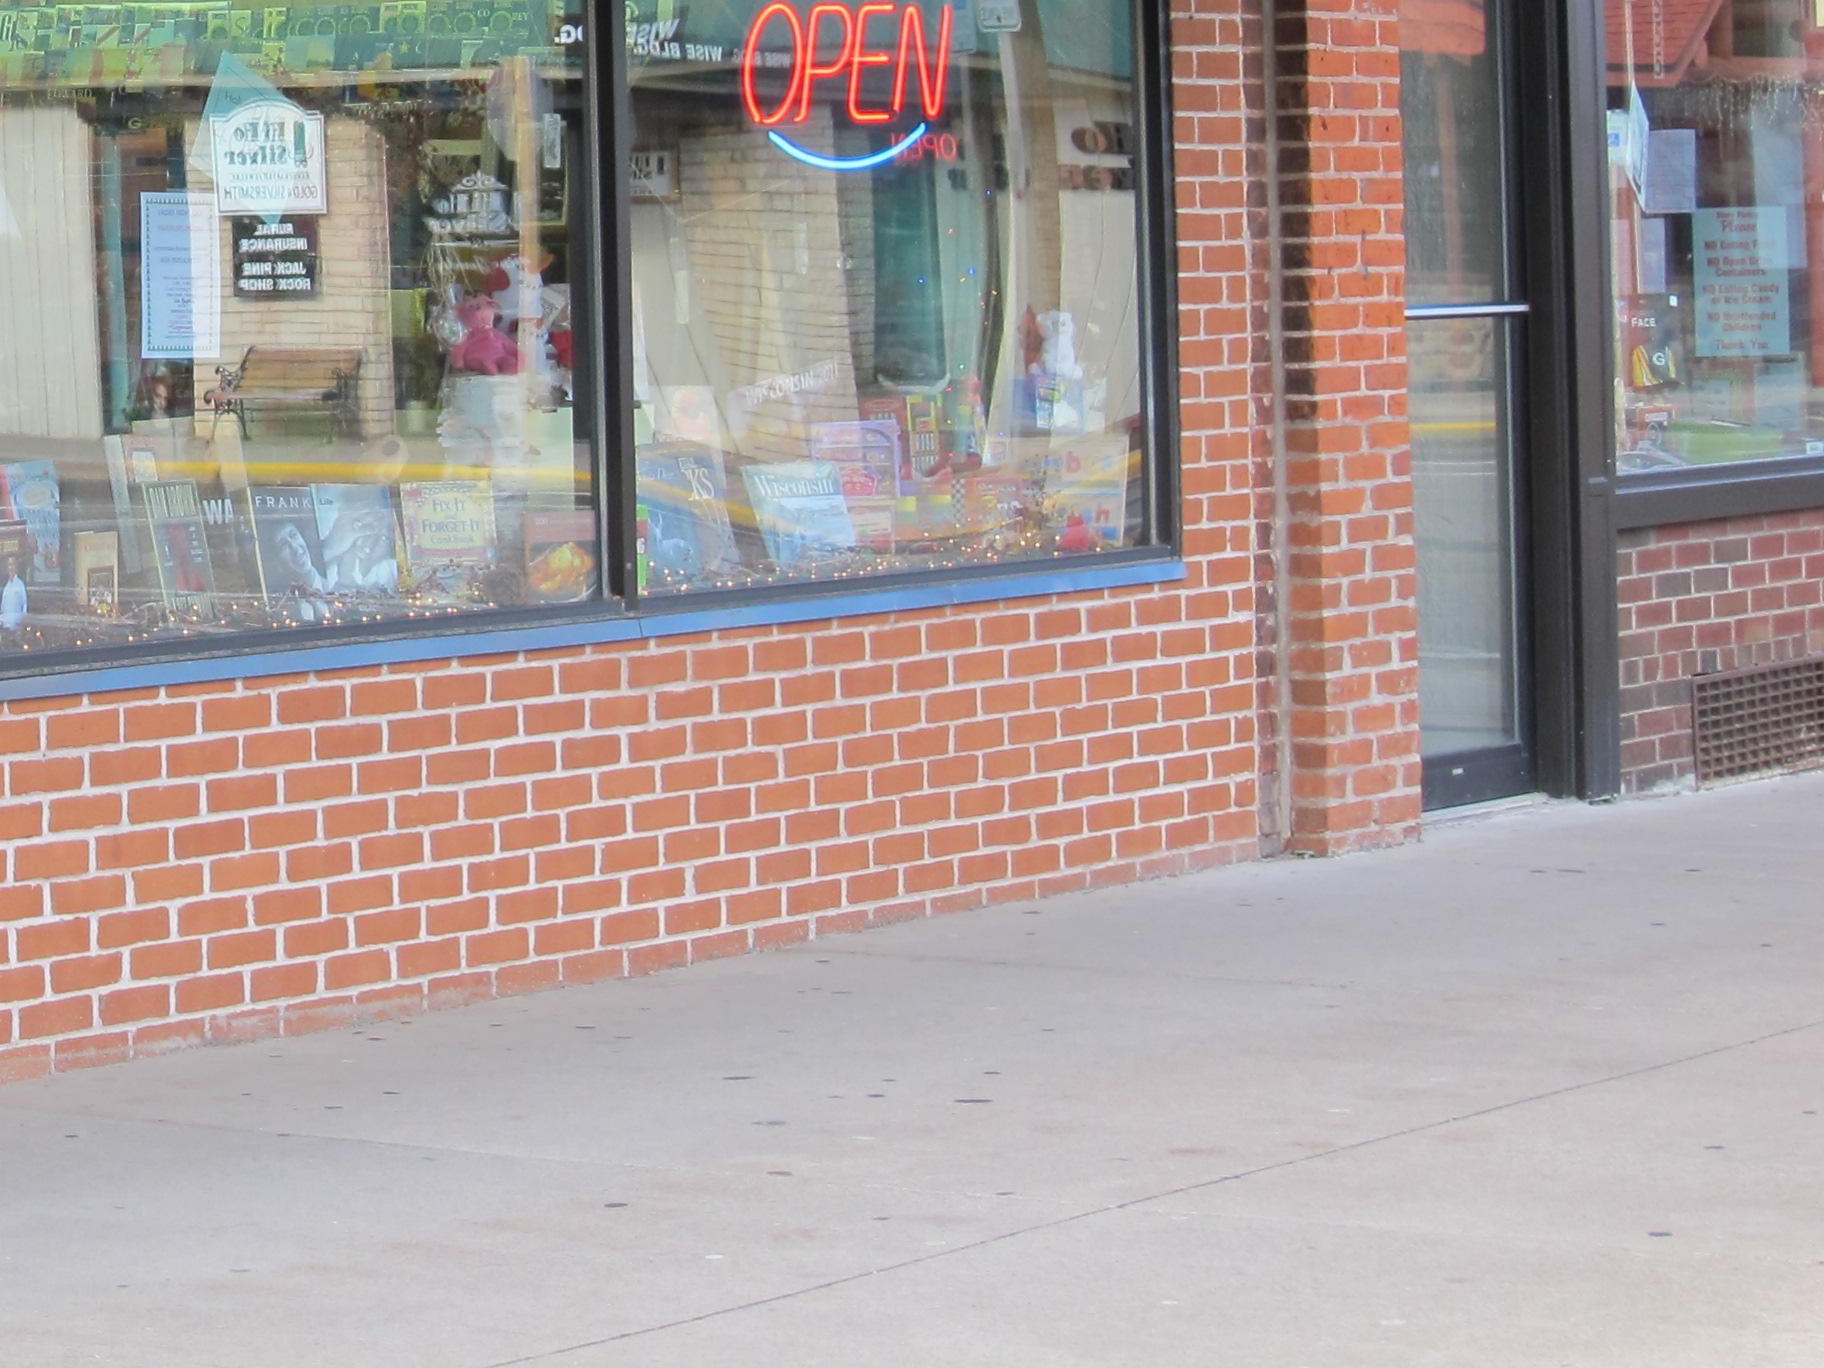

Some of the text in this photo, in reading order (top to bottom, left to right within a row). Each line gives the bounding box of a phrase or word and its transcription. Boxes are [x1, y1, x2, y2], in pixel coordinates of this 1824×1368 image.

[742, 0, 953, 124] OPEN
[1631, 317, 1657, 328] FACE
[753, 474, 834, 498] Wisconsin
[255, 495, 312, 509] FRANK
